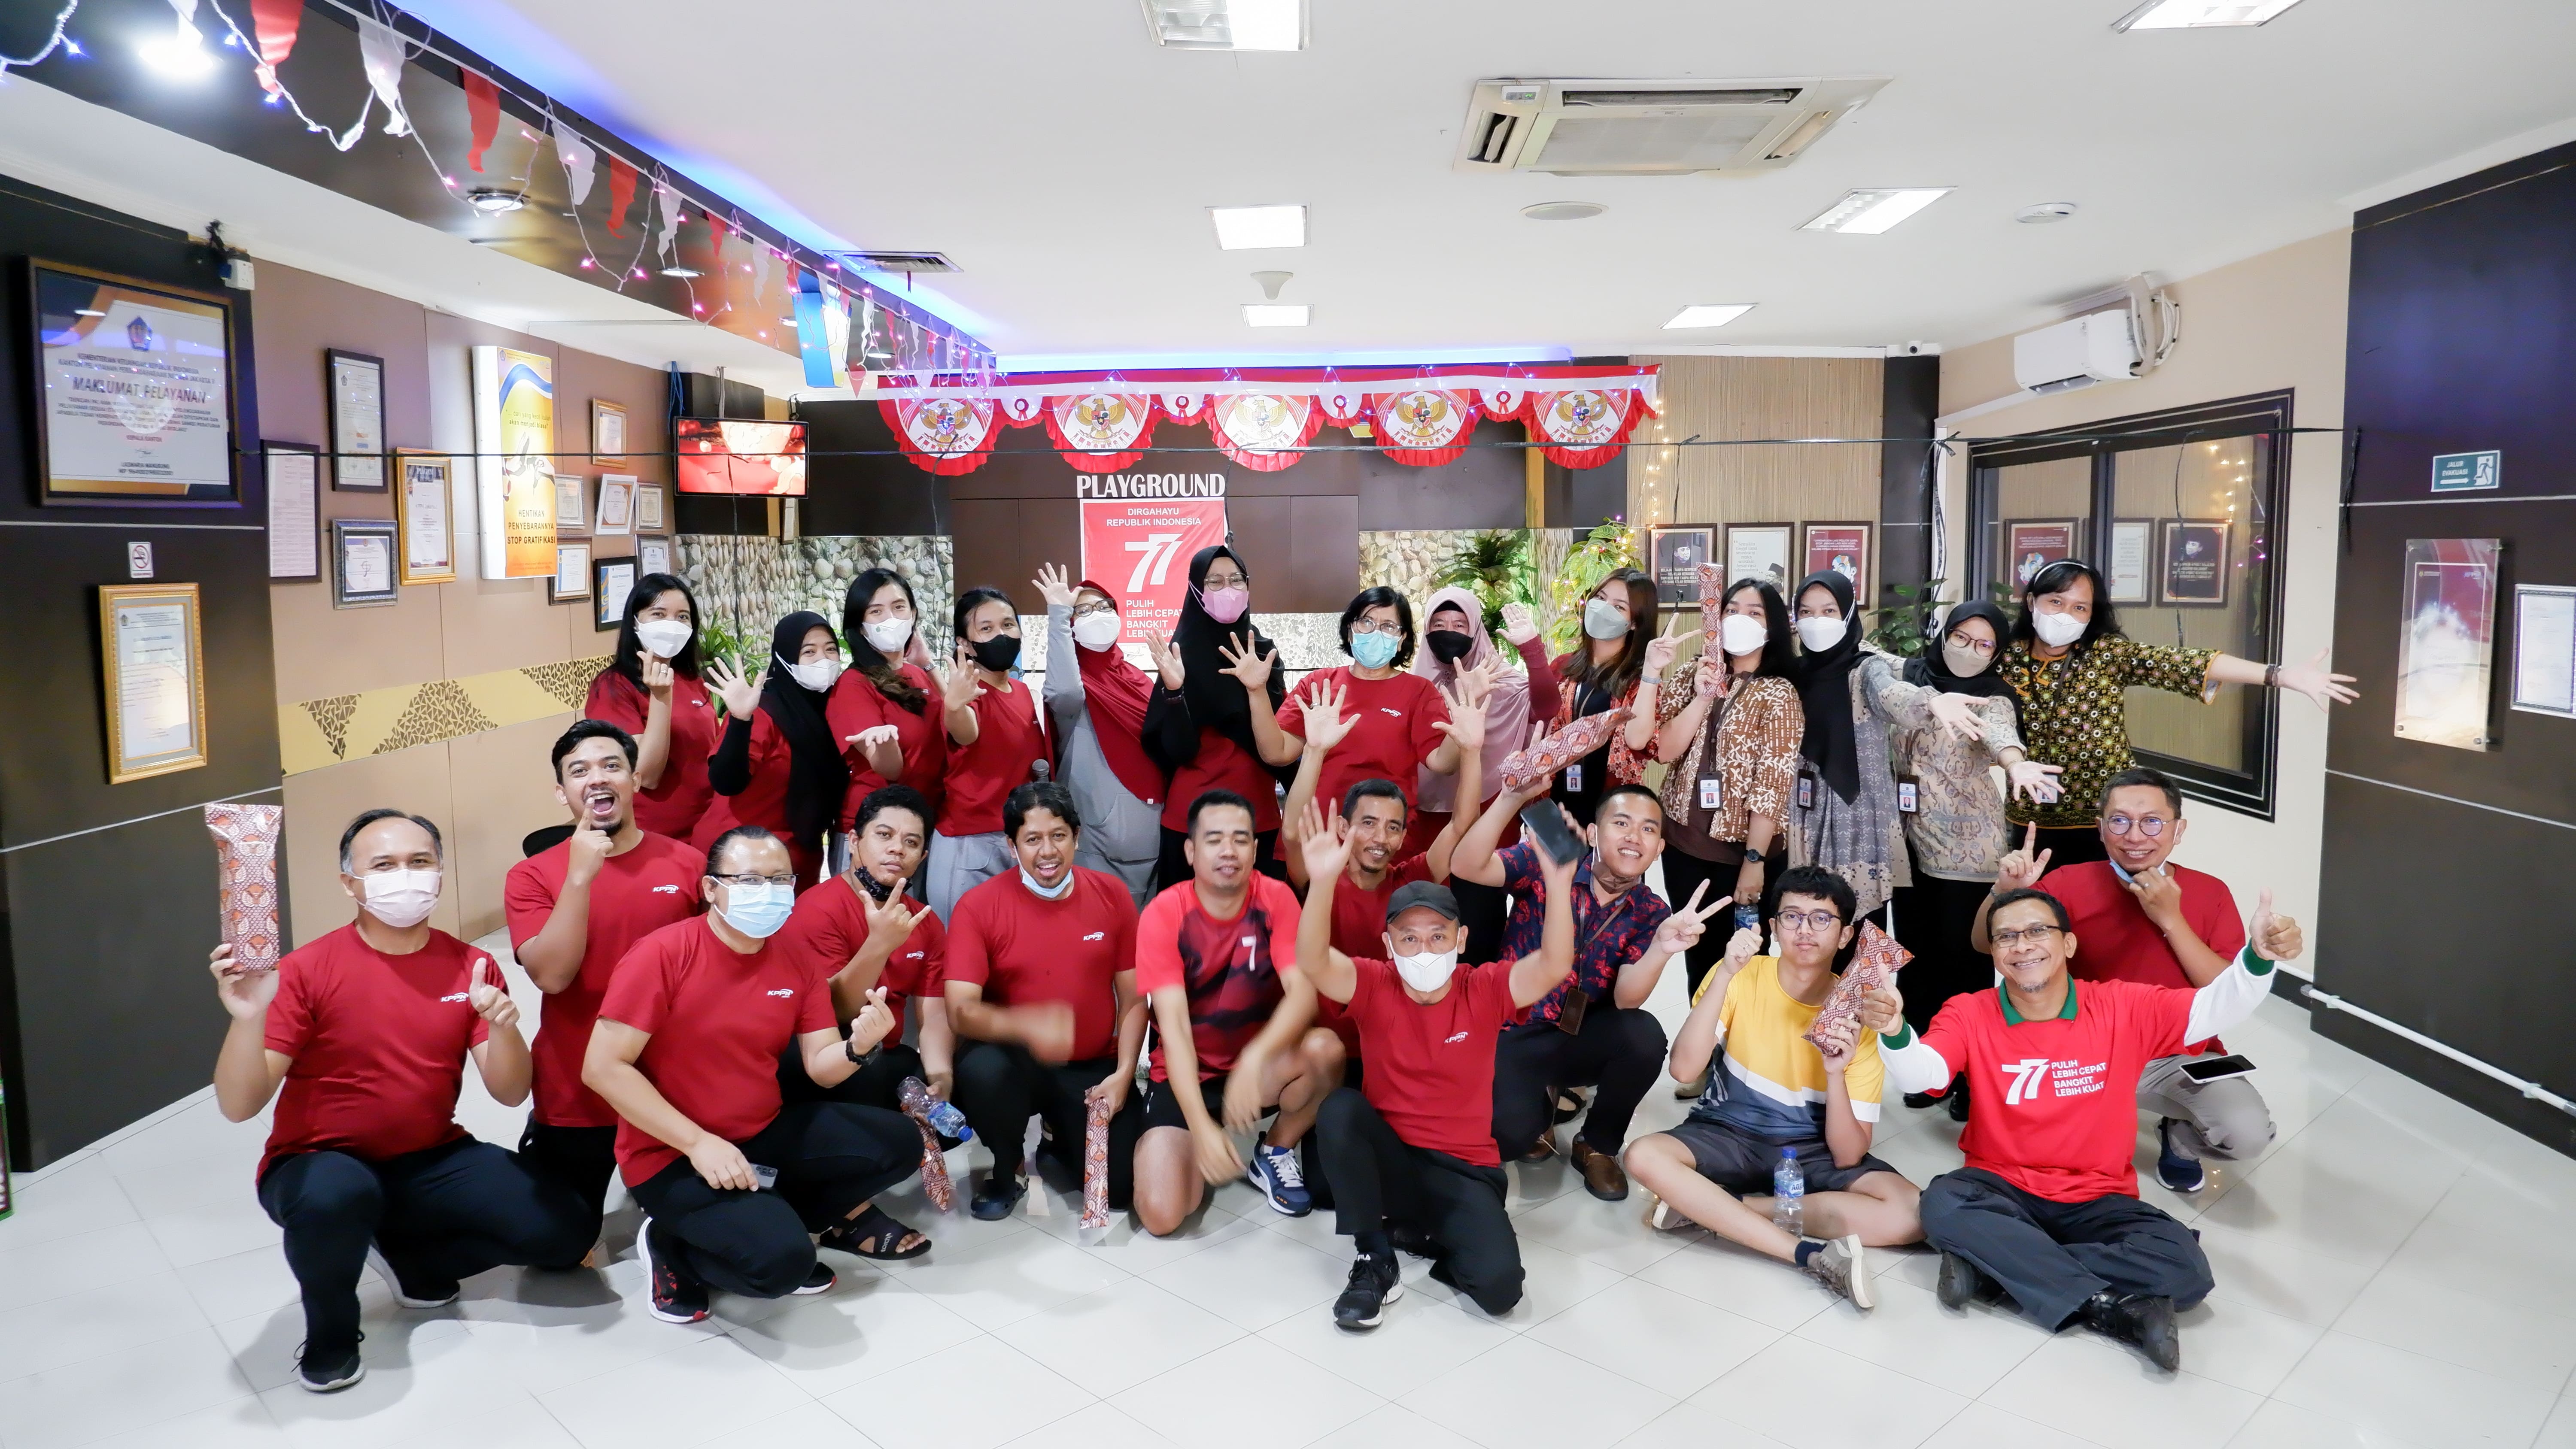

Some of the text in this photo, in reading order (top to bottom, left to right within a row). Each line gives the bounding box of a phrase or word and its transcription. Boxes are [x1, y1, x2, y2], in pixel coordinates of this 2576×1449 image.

[73, 376, 206, 403] MAKLUMAT PELAYANAN
[1076, 474, 1226, 498] PLAYGROUND
[1106, 517, 1201, 526] REPUBLIK INDONESIA
[524, 536, 556, 544] GRATIFIKASI
[1125, 533, 1183, 593] 77
[1126, 599, 1154, 608] PULIH
[1126, 609, 1153, 618] LEBIH
[1127, 620, 1168, 628] BANGKIT
[1155, 629, 1176, 637] UA
[1380, 707, 1401, 717] KPPN
[1083, 932, 1104, 941] KPPN
[1242, 934, 1257, 972] 7
[440, 993, 468, 1002] KPPN
[1444, 1032, 1467, 1043] KPPN
[2051, 1059, 2078, 1070] PULIH
[2052, 1062, 2106, 1079] LEBIH CEPAT
[2002, 1058, 2049, 1105] 77
[2054, 1076, 2093, 1088] BANGKIT
[2055, 1081, 2105, 1097] LEBIH KUAT
